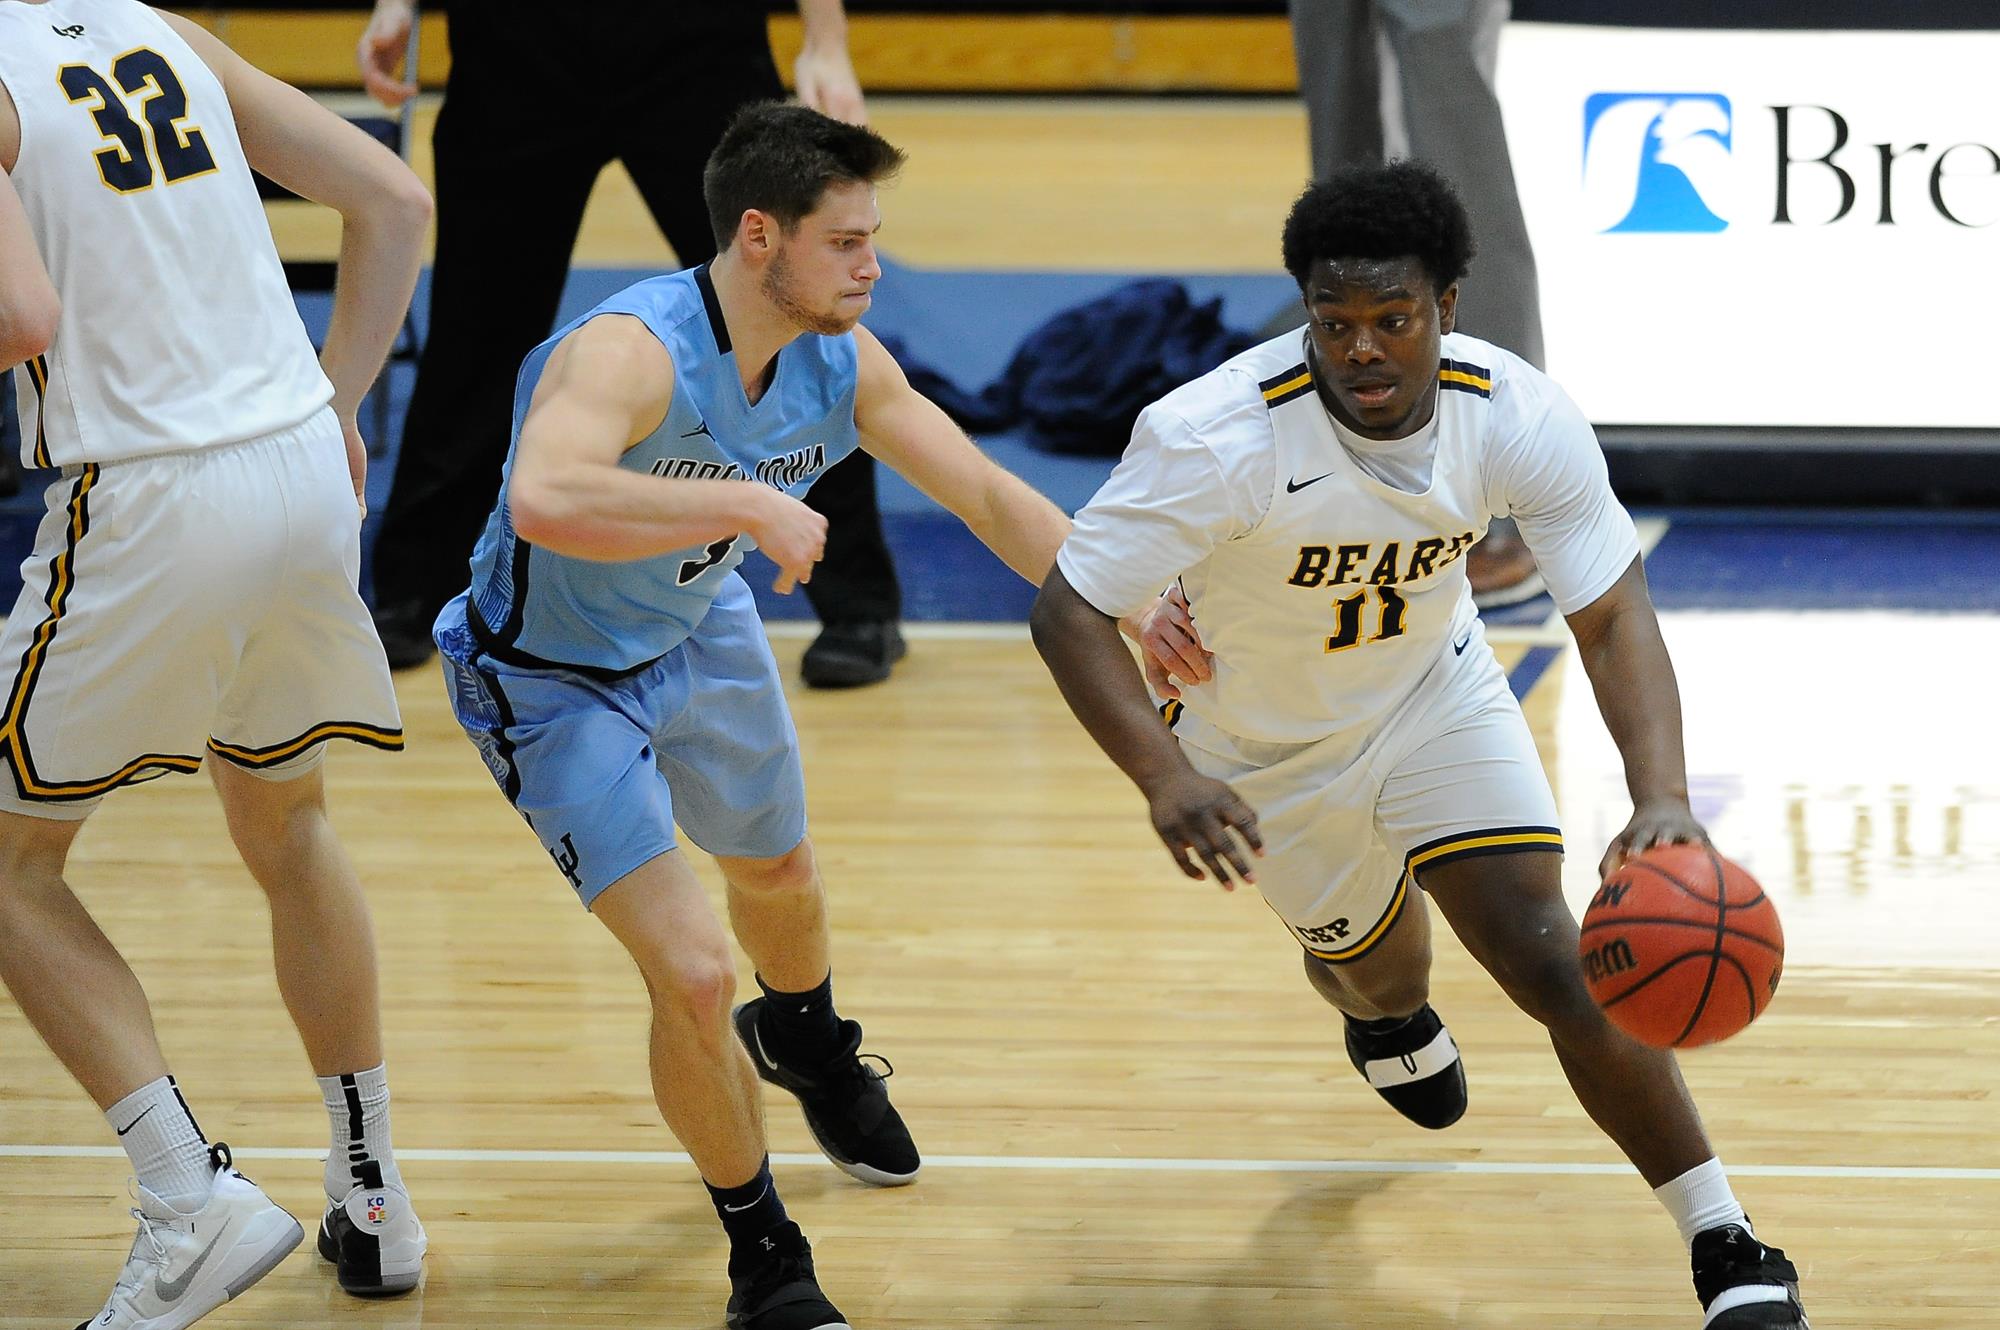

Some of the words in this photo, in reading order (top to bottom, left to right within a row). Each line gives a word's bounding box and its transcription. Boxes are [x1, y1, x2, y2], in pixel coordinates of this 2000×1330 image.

[56, 45, 220, 196] 32
[1764, 104, 2000, 229] Bre
[1323, 585, 1409, 654] 11
